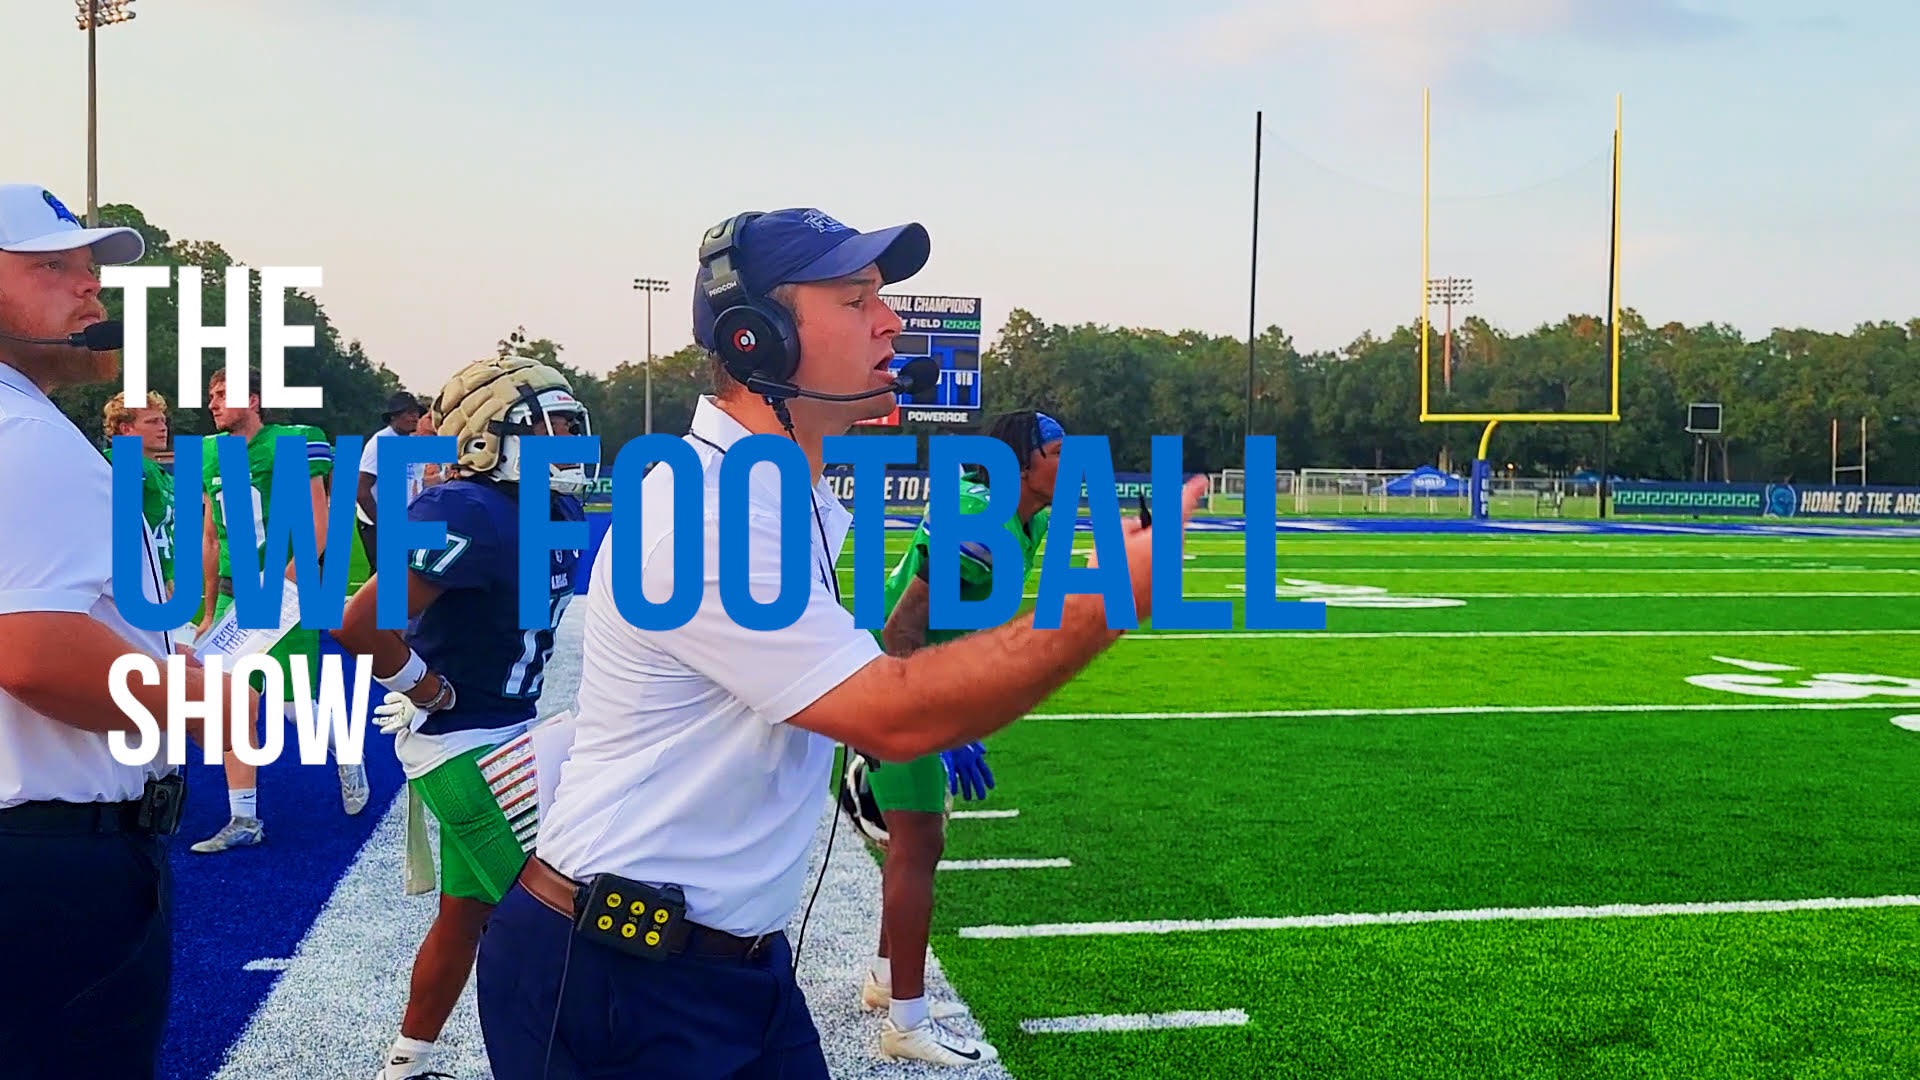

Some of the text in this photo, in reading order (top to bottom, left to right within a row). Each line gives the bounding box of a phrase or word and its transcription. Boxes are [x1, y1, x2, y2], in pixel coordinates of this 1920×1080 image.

[708, 280, 738, 298] PROCOM
[914, 297, 976, 314] CHAMPIONS
[910, 318, 941, 329] FIELD
[907, 411, 968, 423] POWERADE
[898, 476, 920, 500] TO
[1800, 491, 1843, 513] HOME
[1844, 492, 1863, 514] OF
[1866, 492, 1893, 514] THE
